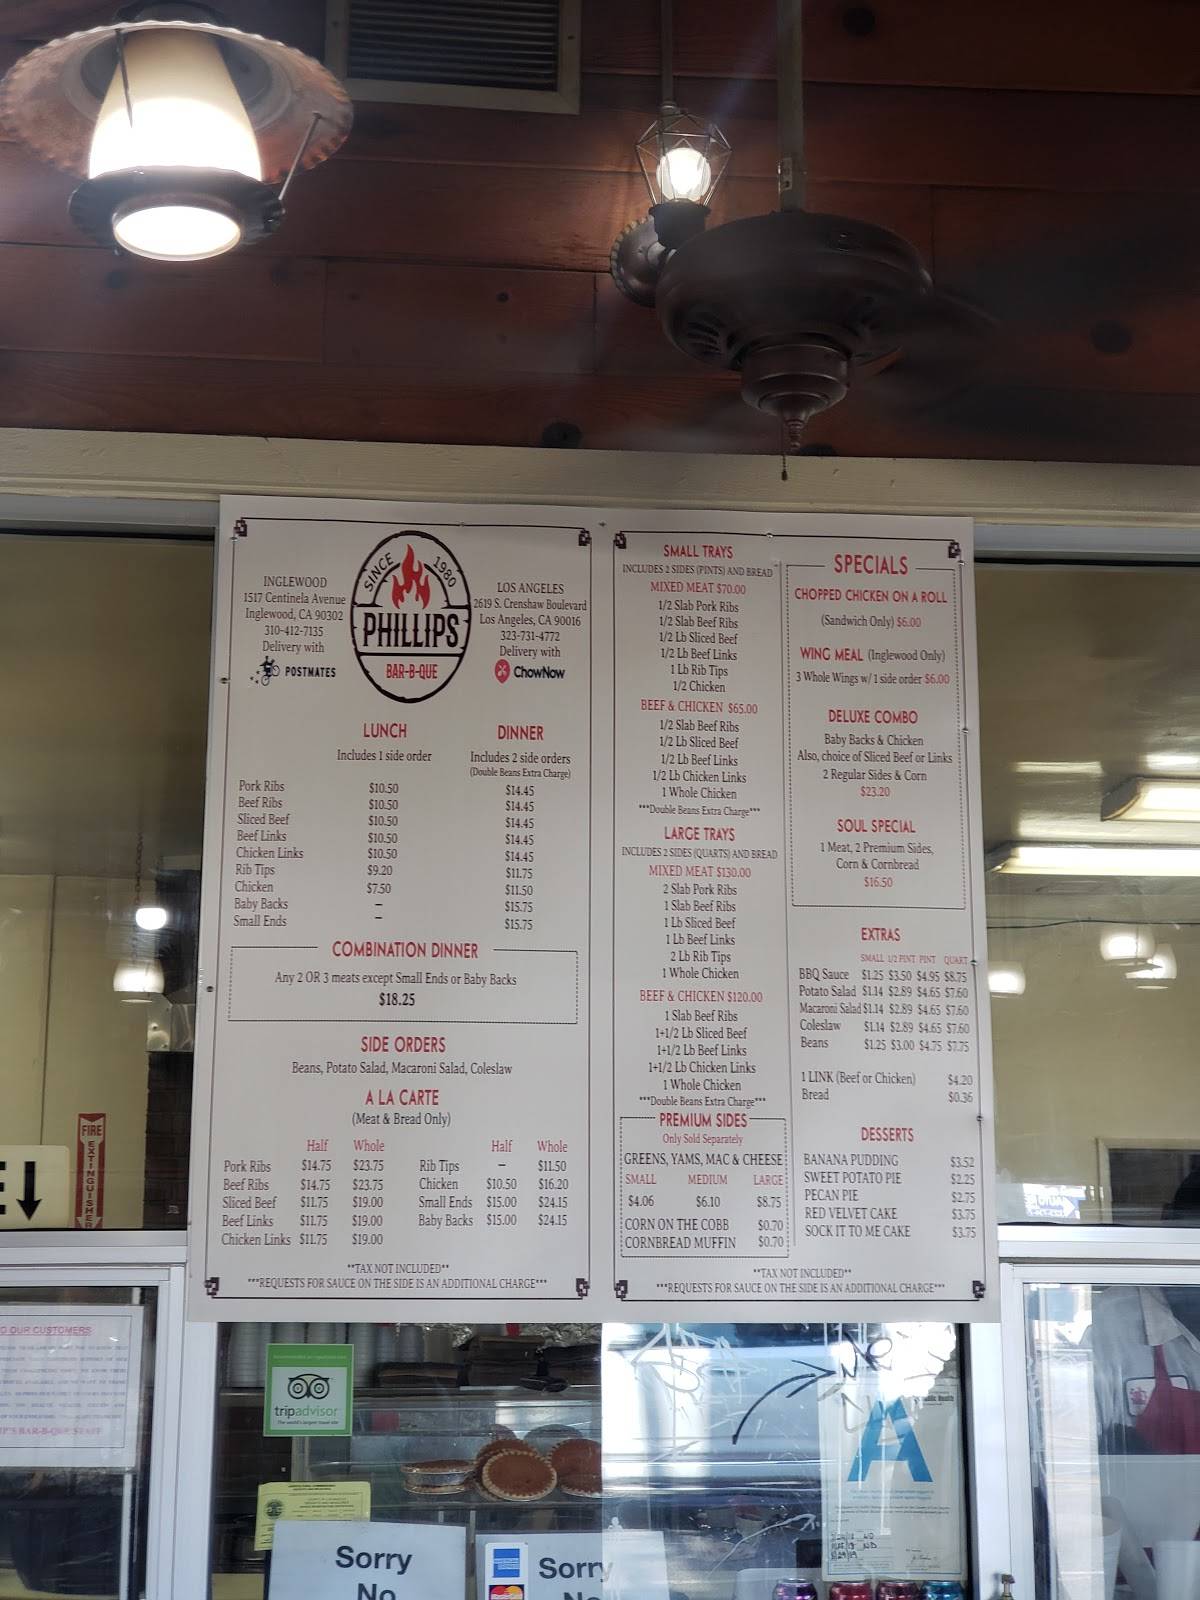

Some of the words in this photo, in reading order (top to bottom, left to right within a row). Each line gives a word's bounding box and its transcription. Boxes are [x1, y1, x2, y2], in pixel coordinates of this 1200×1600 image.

[663, 544, 699, 557] SMALL
[701, 545, 735, 558] TRAYS
[834, 554, 907, 574] SPECIALS
[364, 552, 395, 593] SINCE
[433, 556, 458, 588] 1980
[263, 576, 327, 587] INGLEWOOD
[497, 582, 516, 593] LOS
[518, 582, 564, 594] ANGELES
[650, 580, 684, 592] MIXED
[684, 581, 715, 593] MEAT
[715, 582, 746, 596] $70.00
[244, 592, 263, 602] 1517
[264, 592, 310, 604] Centinela
[310, 594, 346, 605] Avenue
[794, 587, 841, 600] CHOPPED
[845, 589, 888, 602] CHICKEN
[892, 590, 908, 602] ON
[911, 591, 918, 602] A
[921, 591, 947, 603] ROLL
[473, 598, 492, 608] 2619
[493, 598, 502, 608] S.
[502, 598, 544, 609] Crenshaw
[545, 598, 587, 610] Boulevard
[245, 607, 296, 623] Inglewood,
[296, 608, 313, 623] CA
[313, 609, 343, 621] 90302
[479, 613, 495, 624] Los
[497, 613, 536, 627] Angeles,
[536, 614, 552, 626] CA
[553, 615, 581, 626] 90016
[821, 614, 868, 626] (Sandwich
[868, 615, 894, 630] Only)
[896, 616, 921, 628] $6.00
[264, 625, 325, 636] 310-412-7135
[362, 612, 461, 648] PHILLIPS
[500, 630, 560, 641] 323-731-4772
[262, 640, 302, 652] Delivery
[303, 641, 324, 652] with
[499, 645, 538, 657] Delivery
[539, 646, 560, 657] with
[285, 666, 335, 677] POSTMATES
[385, 662, 438, 679] BAR-B-QUE
[513, 665, 565, 678] ChowNow
[673, 679, 687, 691] 1/2
[687, 680, 725, 692] Chicken
[641, 699, 666, 710] BEEF
[666, 700, 676, 711] &
[676, 700, 724, 712] CHICKEN
[728, 702, 757, 714] $65.00
[828, 709, 870, 723] DELUXE
[874, 710, 918, 723] COMBO
[363, 722, 406, 738] LUNCH
[498, 724, 543, 740] DINNER
[337, 748, 376, 760] Includes
[378, 750, 382, 760] 1
[385, 749, 404, 761] side
[406, 752, 432, 761] order
[470, 751, 510, 762] Includes
[512, 752, 517, 763] 2
[518, 752, 538, 763] side
[539, 755, 570, 764] orders
[239, 779, 262, 791] Pork
[263, 780, 284, 792] Ribs
[369, 782, 398, 794] $10.50
[505, 784, 534, 796] $14.45
[859, 785, 891, 797] $23.20
[837, 818, 867, 832] SOUL
[871, 819, 915, 833] SPECIAL
[664, 826, 700, 840] LARGE
[703, 827, 734, 841] TRAYS
[235, 862, 252, 875] Rib
[253, 863, 275, 878] Tips
[367, 864, 392, 876] $9.20
[506, 867, 532, 879] $11.75
[649, 864, 683, 876] MIXED
[683, 864, 714, 879] MEAT
[714, 864, 751, 880] $130.00
[864, 876, 893, 887] $16.50
[861, 927, 900, 941] EXTRAS
[332, 941, 426, 957] COMBINATION
[431, 942, 478, 958] DINNER
[799, 967, 821, 981] BBQ
[821, 968, 849, 980] Sauce
[861, 969, 884, 980] $1.25
[885, 969, 912, 981] $3.50
[916, 970, 941, 982] $4.95
[943, 970, 967, 982] $8.75
[379, 992, 414, 1006] $18.25
[360, 1036, 389, 1052] SIDE
[394, 1036, 445, 1052] ORDERS
[292, 1061, 323, 1073] Beans,
[326, 1061, 357, 1073] Potato
[359, 1061, 388, 1073] Salad,
[391, 1062, 436, 1073] Macaroni
[438, 1061, 468, 1074] Salad,
[470, 1062, 512, 1074] Coleslaw
[365, 1090, 373, 1104] A
[378, 1089, 394, 1105] LA
[399, 1089, 438, 1105] CARTE
[352, 1112, 380, 1124] (Meat
[382, 1112, 390, 1124] &
[393, 1112, 421, 1124] Bread
[424, 1112, 450, 1127] Only)
[659, 1112, 711, 1127] PREMIUM
[715, 1112, 749, 1127] SIDES
[82, 1125, 102, 1136] FIRE
[861, 1127, 913, 1141] DESSERTS
[306, 1138, 328, 1152] Half
[353, 1138, 384, 1151] Whole
[662, 1131, 682, 1146] Only
[682, 1132, 700, 1144] Sold
[701, 1133, 743, 1145] Separately
[491, 1139, 512, 1152] Half
[537, 1139, 567, 1152] Whole
[223, 1159, 248, 1172] Pork
[248, 1160, 271, 1172] Ribs
[301, 1159, 333, 1171] $14.75
[353, 1159, 383, 1171] $23.75
[538, 1160, 566, 1172] $11.50
[803, 1153, 848, 1165] BANANA
[850, 1153, 898, 1166] PUDDING
[419, 1159, 436, 1171] Rib
[438, 1159, 459, 1175] Tips
[624, 1173, 656, 1184] SMALL
[688, 1173, 727, 1185] MEDIUM
[753, 1174, 785, 1186] LARGE
[628, 1194, 654, 1206] $4.06
[696, 1195, 720, 1207] $6.10
[804, 1188, 839, 1201] PECAN
[842, 1188, 859, 1201] PIE
[756, 1195, 783, 1208] $8.75
[624, 1217, 655, 1230] CORN
[657, 1218, 673, 1230] ON
[676, 1218, 698, 1230] THE
[700, 1218, 729, 1231] COBB
[758, 1219, 783, 1231] $0.70
[374, 1263, 393, 1273] NOT
[33, 1326, 92, 1335] CUSTOMERS
[274, 1405, 337, 1419] tripadvisor
[847, 1396, 934, 1482] A
[335, 1545, 413, 1575] Sorry
[538, 1557, 613, 1582] Sorry
[357, 1583, 396, 1600] No
